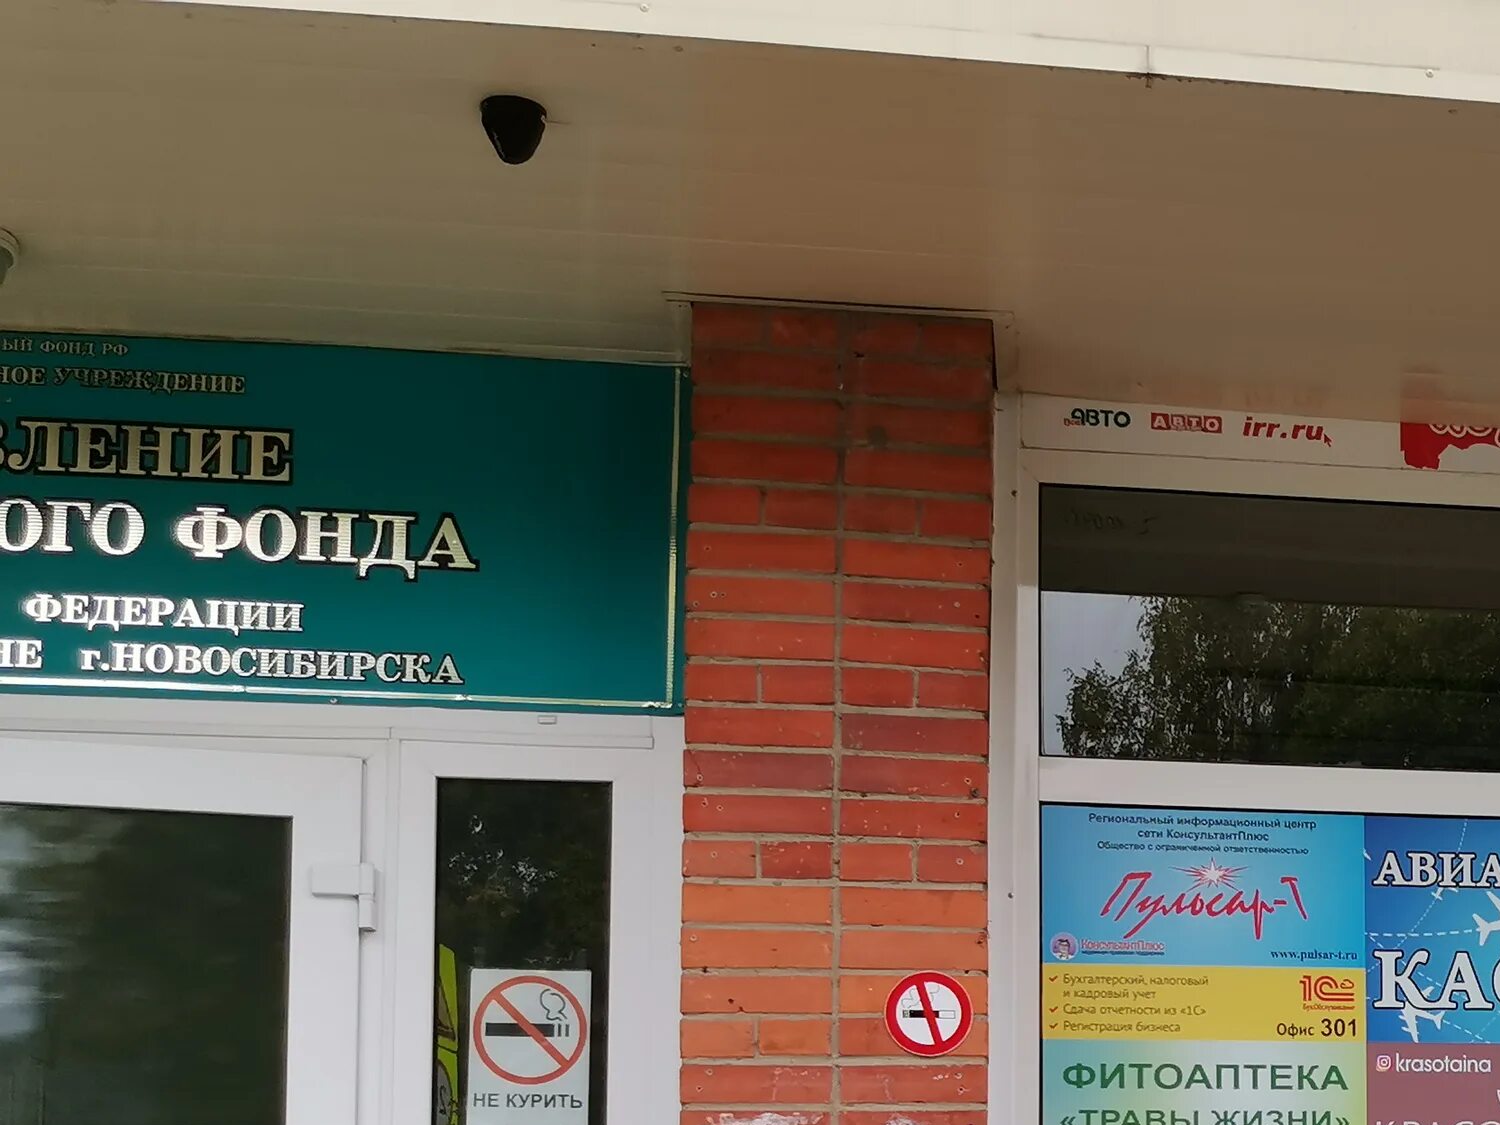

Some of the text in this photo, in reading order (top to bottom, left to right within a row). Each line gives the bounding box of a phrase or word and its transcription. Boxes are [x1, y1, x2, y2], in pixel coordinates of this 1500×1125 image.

[40, 340, 96, 357] ФОНД
[102, 342, 128, 356] РФ
[54, 367, 246, 394] УЧРЕЖДЕНИЕ
[0, 420, 291, 482] ЛЕНИЕ
[174, 506, 478, 581] ФОНДА
[24, 592, 305, 636] ФЕДЕРАЦИИ
[80, 642, 465, 685] г.НОВОСИБИРСКА
[1089, 813, 1317, 830] Региональный информационный центр
[1137, 830, 1164, 838] сети
[1271, 950, 1357, 961] www.pulsar-t.ru
[1063, 974, 1209, 987] Бухгалтерский, налоговый
[1074, 989, 1129, 1000] кадровый
[1133, 992, 1156, 1000] учет
[1063, 1004, 1096, 1015] Сдача
[1100, 1007, 1160, 1015] отчетности
[1063, 1021, 1180, 1033] Регистрация бизнеса
[1277, 1019, 1356, 1039] Офис 301
[1396, 1054, 1492, 1073] krasotaina
[1062, 1063, 1349, 1090] ФИТОАПТЕКА
[473, 1093, 583, 1109] НЕ КУРИТЬ
